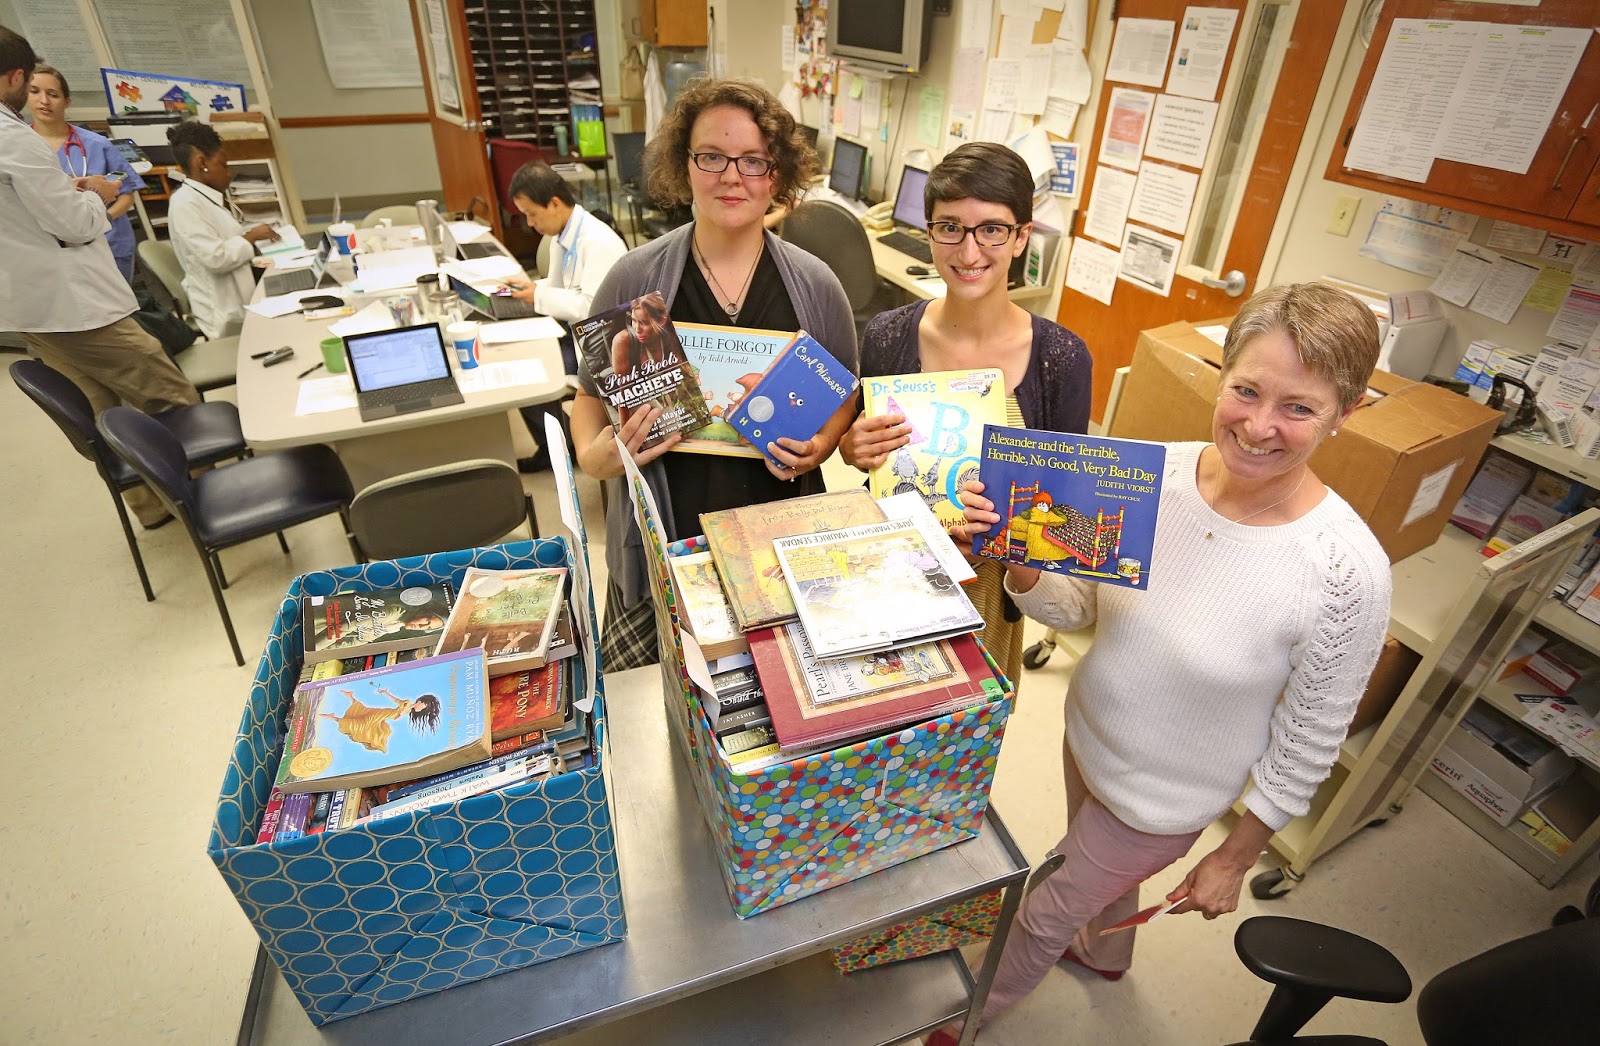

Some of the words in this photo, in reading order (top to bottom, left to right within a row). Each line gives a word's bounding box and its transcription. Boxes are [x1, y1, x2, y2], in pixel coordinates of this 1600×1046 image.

[717, 338, 776, 354] FORGOT
[699, 353, 706, 363] by
[708, 354, 723, 362] Tedd
[725, 356, 748, 364] Arnold
[604, 365, 639, 390] Pink
[641, 352, 679, 375] Boots
[795, 345, 818, 369] Carl
[816, 363, 847, 399] Hiaasen
[609, 368, 684, 407] MACHETE
[871, 382, 890, 397] Dr.
[893, 379, 937, 393] Seuss's
[662, 407, 686, 420] Mayor
[988, 432, 1037, 449] Alexander
[1038, 440, 1057, 451] and
[1058, 442, 1074, 454] the
[1076, 443, 1120, 462] Terrible,
[987, 448, 1028, 466] Horrible,
[1029, 454, 1046, 467] No
[1048, 457, 1080, 474] Good,
[1082, 461, 1107, 477] Very
[1109, 466, 1130, 479] Bad
[1133, 468, 1157, 483] Day
[1096, 480, 1124, 490] JUDITH
[1128, 484, 1155, 494] VIORST
[892, 518, 915, 530] JAMES
[779, 536, 813, 547] SENDAK
[813, 531, 848, 542] MAURICE
[502, 589, 523, 601] Boy
[502, 608, 527, 618] Belle
[492, 646, 520, 655] RUTH
[466, 661, 474, 680] PAM
[807, 661, 830, 697] Pearl's
[844, 672, 860, 691] JANE
[466, 684, 476, 720] MUÑOZ
[516, 690, 530, 718] PONY
[736, 711, 756, 720] ASHER
[291, 721, 302, 750] SCHOLASTIC
[488, 753, 512, 766] PAULSEN
[511, 749, 528, 759] GARY
[417, 784, 452, 800] Dogsong
[461, 780, 490, 794] WALK
[433, 790, 460, 803] TWO
[1466, 782, 1508, 815] Aquaphor
[389, 800, 432, 816] MOONS
